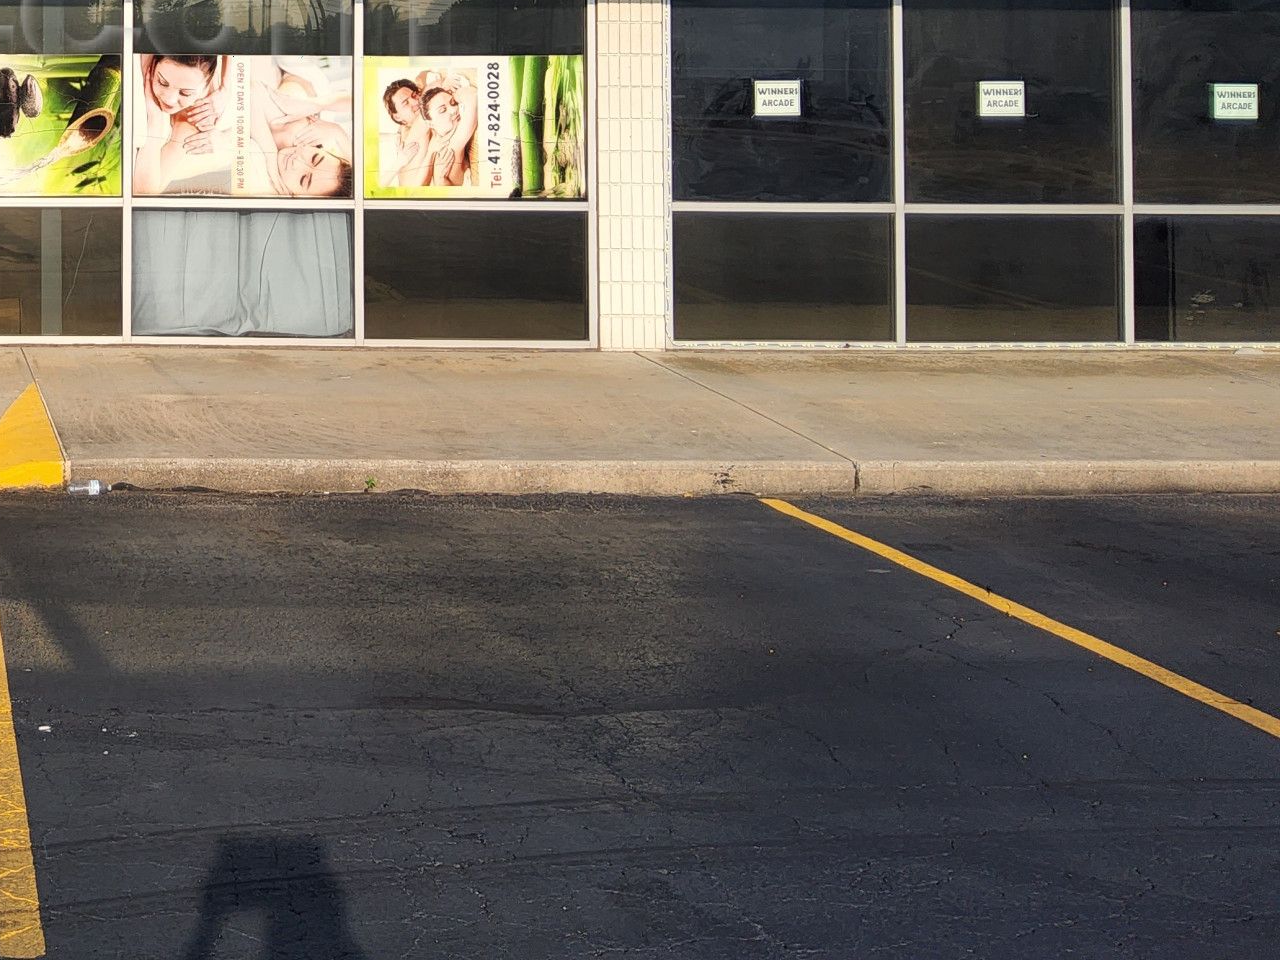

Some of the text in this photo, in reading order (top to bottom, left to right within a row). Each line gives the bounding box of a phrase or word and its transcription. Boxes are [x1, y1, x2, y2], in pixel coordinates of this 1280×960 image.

[236, 62, 245, 83] OPEN
[236, 91, 245, 111] DAYS
[762, 99, 795, 107] ARCADE
[986, 99, 1019, 108] ARCADE
[1220, 102, 1253, 110] ARCADE
[486, 61, 502, 189] Tel: 417-824-0028
[236, 136, 245, 148] AM
[236, 177, 245, 189] PM
